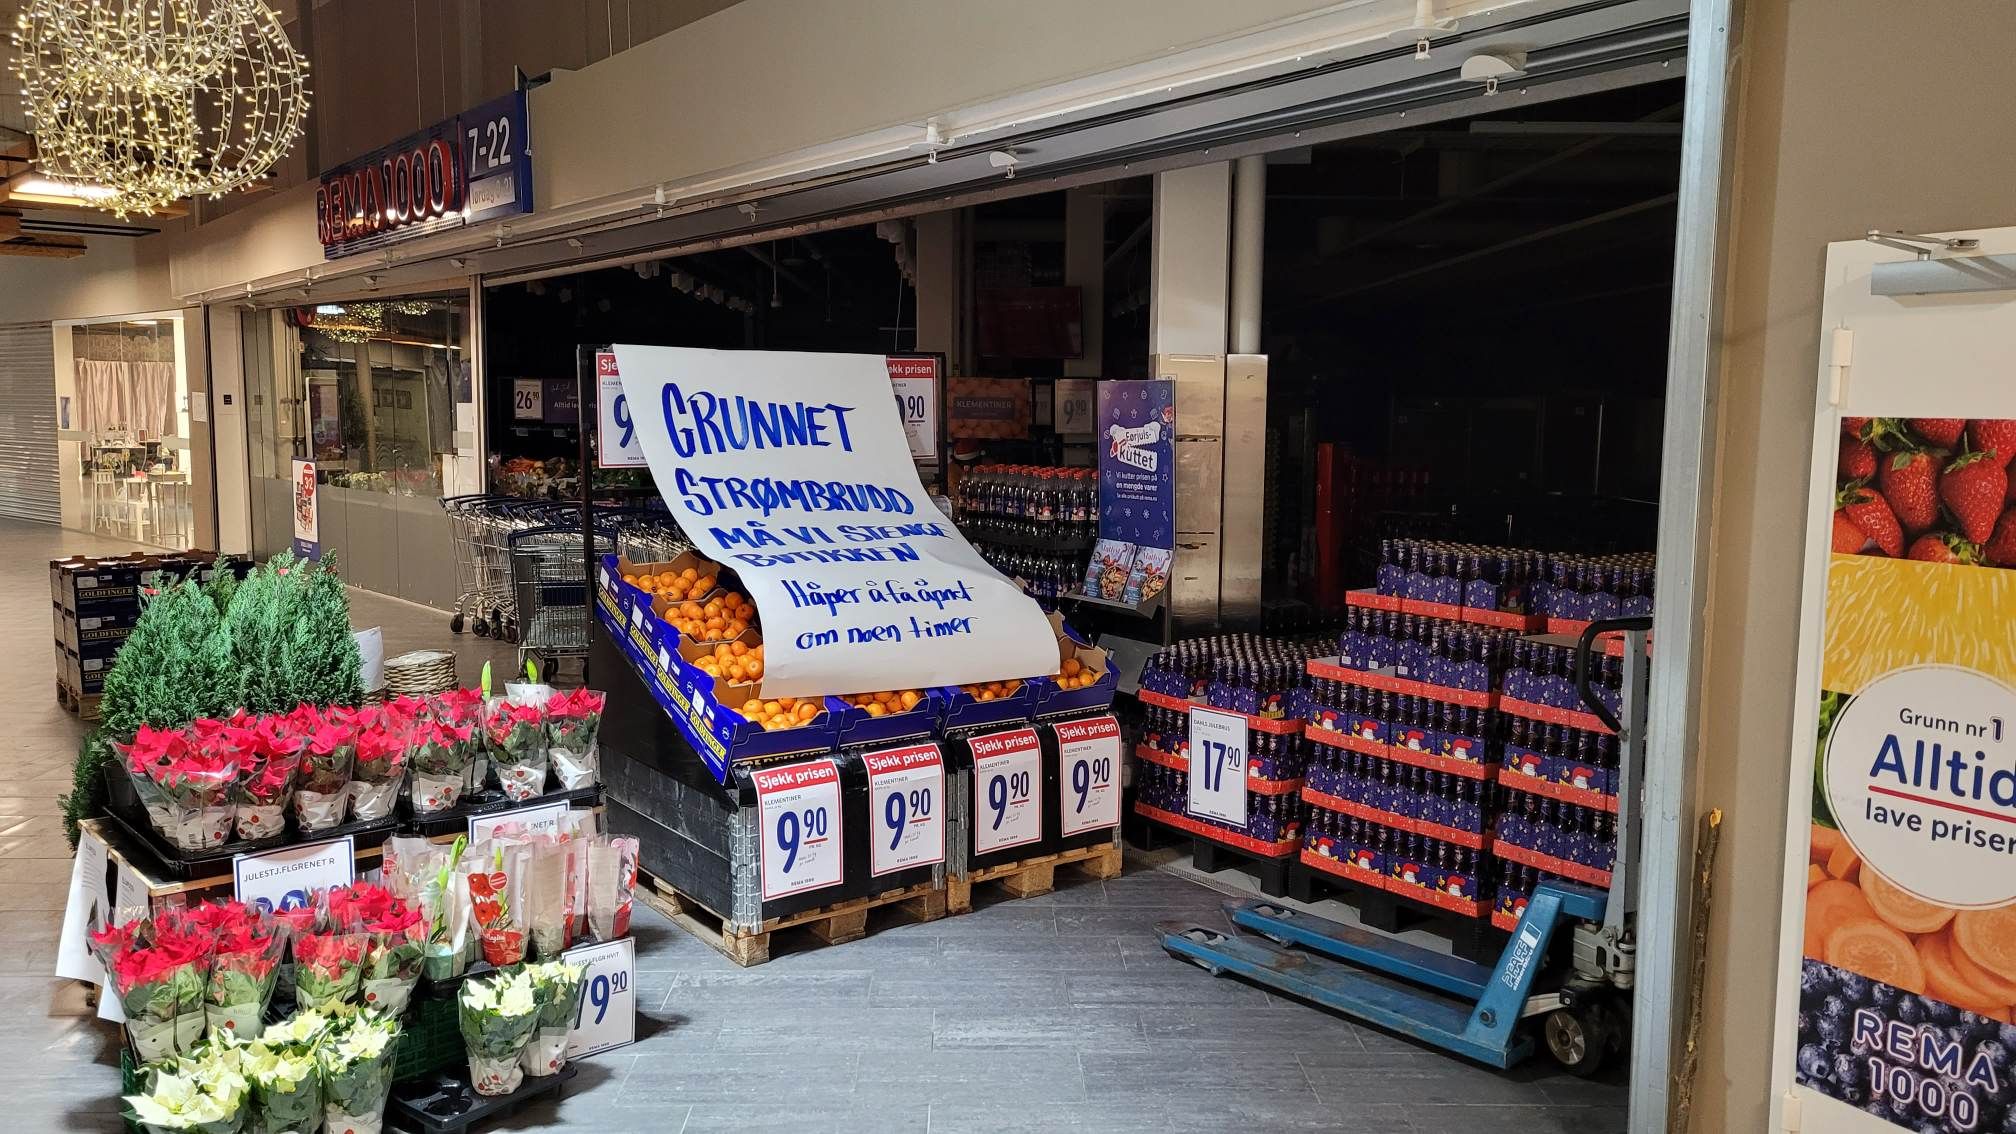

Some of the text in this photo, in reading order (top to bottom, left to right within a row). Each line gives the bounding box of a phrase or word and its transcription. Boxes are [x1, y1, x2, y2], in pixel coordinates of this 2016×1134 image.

[468, 116, 511, 173] 7-22
[316, 141, 446, 244] REMA 1000
[601, 358, 618, 373] Sje
[888, 363, 932, 376] ekk prisen
[516, 390, 533, 410] 26
[907, 395, 925, 419] 90
[614, 393, 634, 449] 9
[662, 382, 856, 459] GRUNNET
[1116, 471, 1121, 479] Vi
[1120, 446, 1154, 470] kuttet
[675, 467, 915, 517] STRØMBRUDD
[1123, 482, 1143, 491] mengde
[708, 520, 953, 549] MÅ VI STENGE
[729, 542, 920, 568] BUTIKKEN
[79, 587, 134, 598] GOLDFINGER
[599, 586, 627, 628] GOLDFINGER
[781, 579, 866, 617] Håper
[866, 580, 885, 599] å
[914, 578, 975, 610] åpnet
[796, 616, 979, 650] om noen timer
[657, 665, 691, 715] GOLDFINGER
[690, 709, 726, 762] GOLDFINGER
[1059, 721, 1117, 740] Sjekk prisen
[1193, 719, 1208, 727] DAHLS
[1208, 722, 1231, 732] JULEBRUS
[1899, 707, 2004, 741] Grunn nr 1
[868, 750, 938, 771] Sjekk prisen
[974, 735, 1036, 755] Sjekk prisen
[758, 766, 834, 790] Sjekk prisen
[1203, 739, 1241, 793] 17 90
[1869, 733, 2016, 809] Alltid
[764, 794, 801, 806] KLEMENTINER
[988, 770, 1030, 831] 9 90
[1072, 757, 1110, 814] 9 90
[885, 787, 931, 851] 9 90
[1866, 798, 1922, 832] lave
[776, 806, 828, 874] 9 90
[243, 857, 335, 882] JULESTJ.FLGRENET R
[611, 970, 628, 992] 90
[1854, 1008, 1999, 1093] REMA
[1868, 1056, 1978, 1130] 1000
